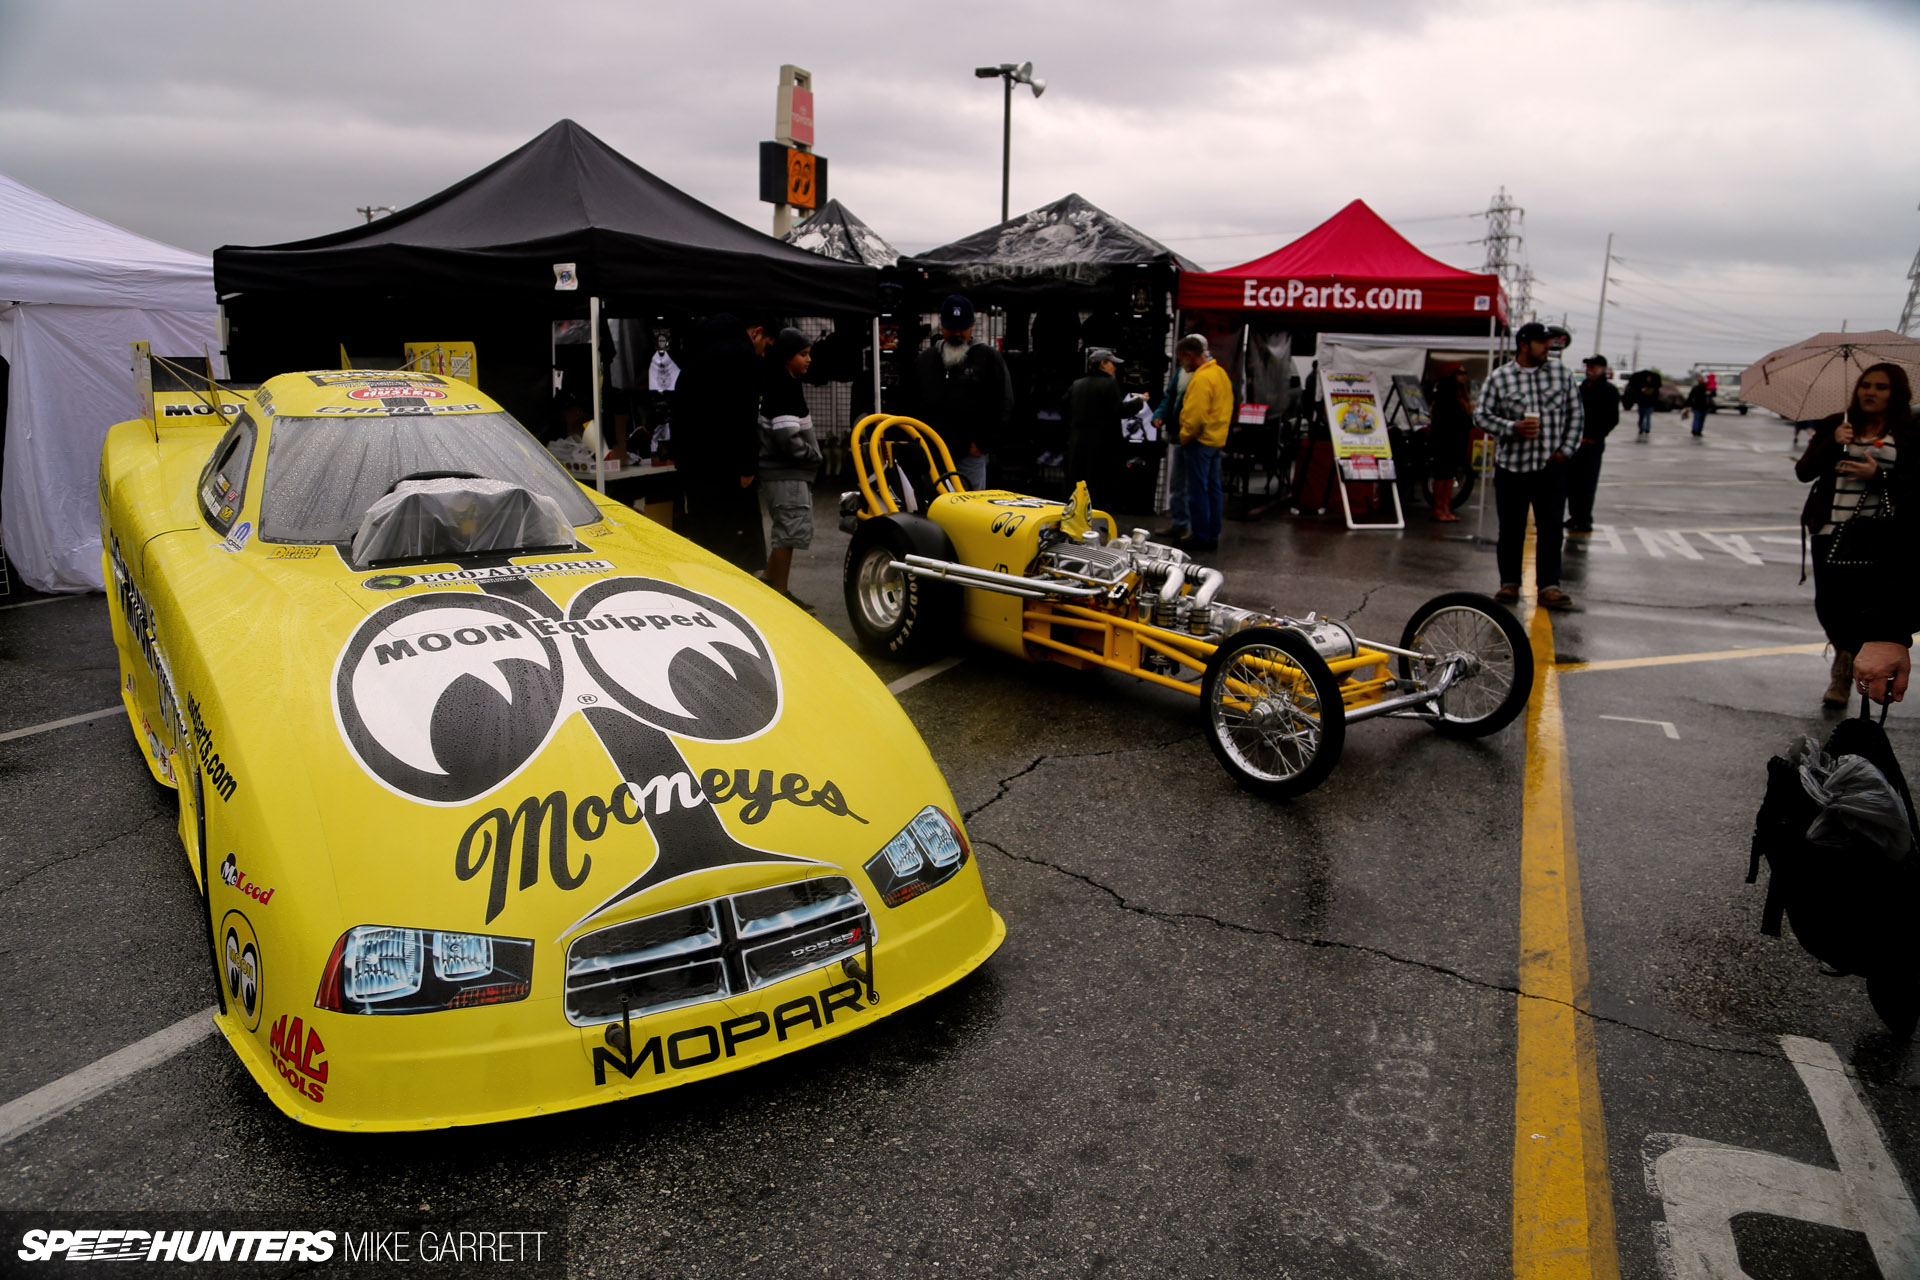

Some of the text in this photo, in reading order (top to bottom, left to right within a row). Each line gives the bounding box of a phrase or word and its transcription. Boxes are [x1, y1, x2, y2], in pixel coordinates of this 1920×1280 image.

[1243, 279, 1422, 310] EcoParts.com
[313, 403, 483, 414] CHARGER
[373, 611, 718, 666] MOON Equipped
[889, 572, 919, 652] OODYEAR
[455, 768, 869, 925] Mooneyes
[221, 861, 275, 905] McLeod
[229, 944, 253, 981] MOON
[791, 932, 854, 957] DODGE
[269, 1014, 328, 1084] MAC
[592, 978, 868, 1086] MOPAR
[270, 1049, 325, 1104] TOOLS
